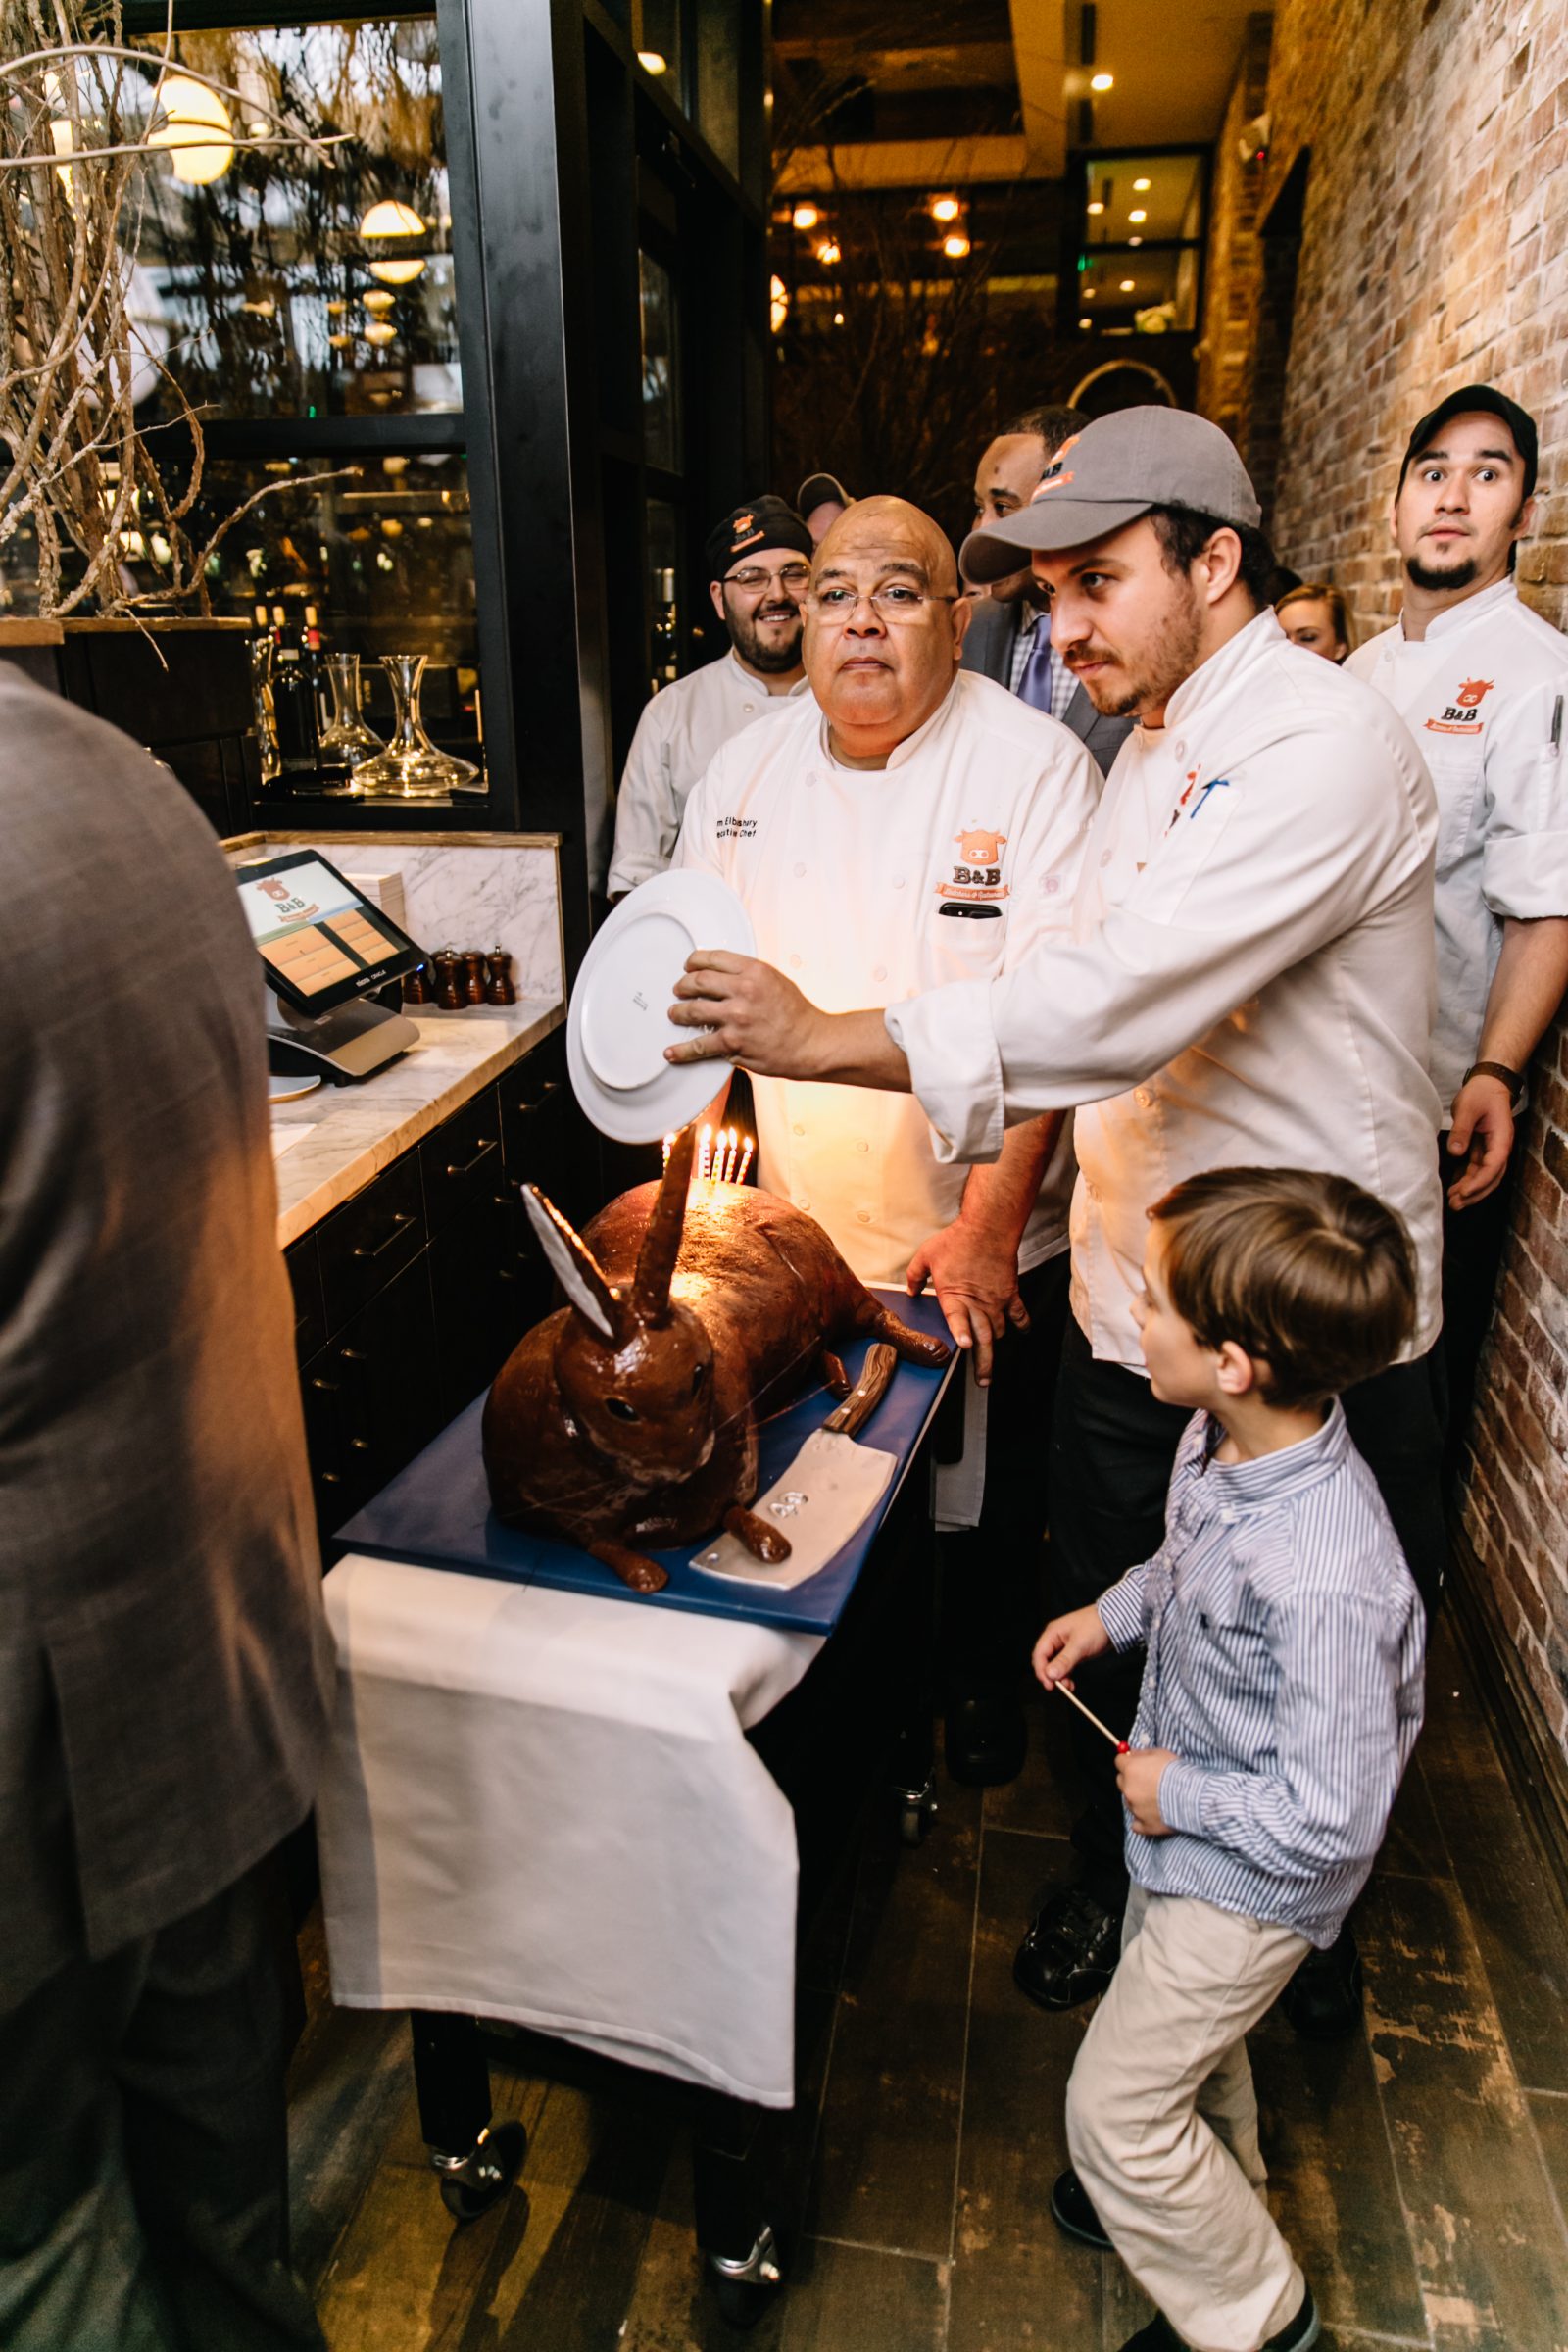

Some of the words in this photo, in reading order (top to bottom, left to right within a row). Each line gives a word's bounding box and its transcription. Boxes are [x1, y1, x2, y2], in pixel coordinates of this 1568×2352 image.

[1441, 707, 1478, 721] B&B
[953, 866, 1001, 886] B&B
[274, 897, 305, 912] B&B
